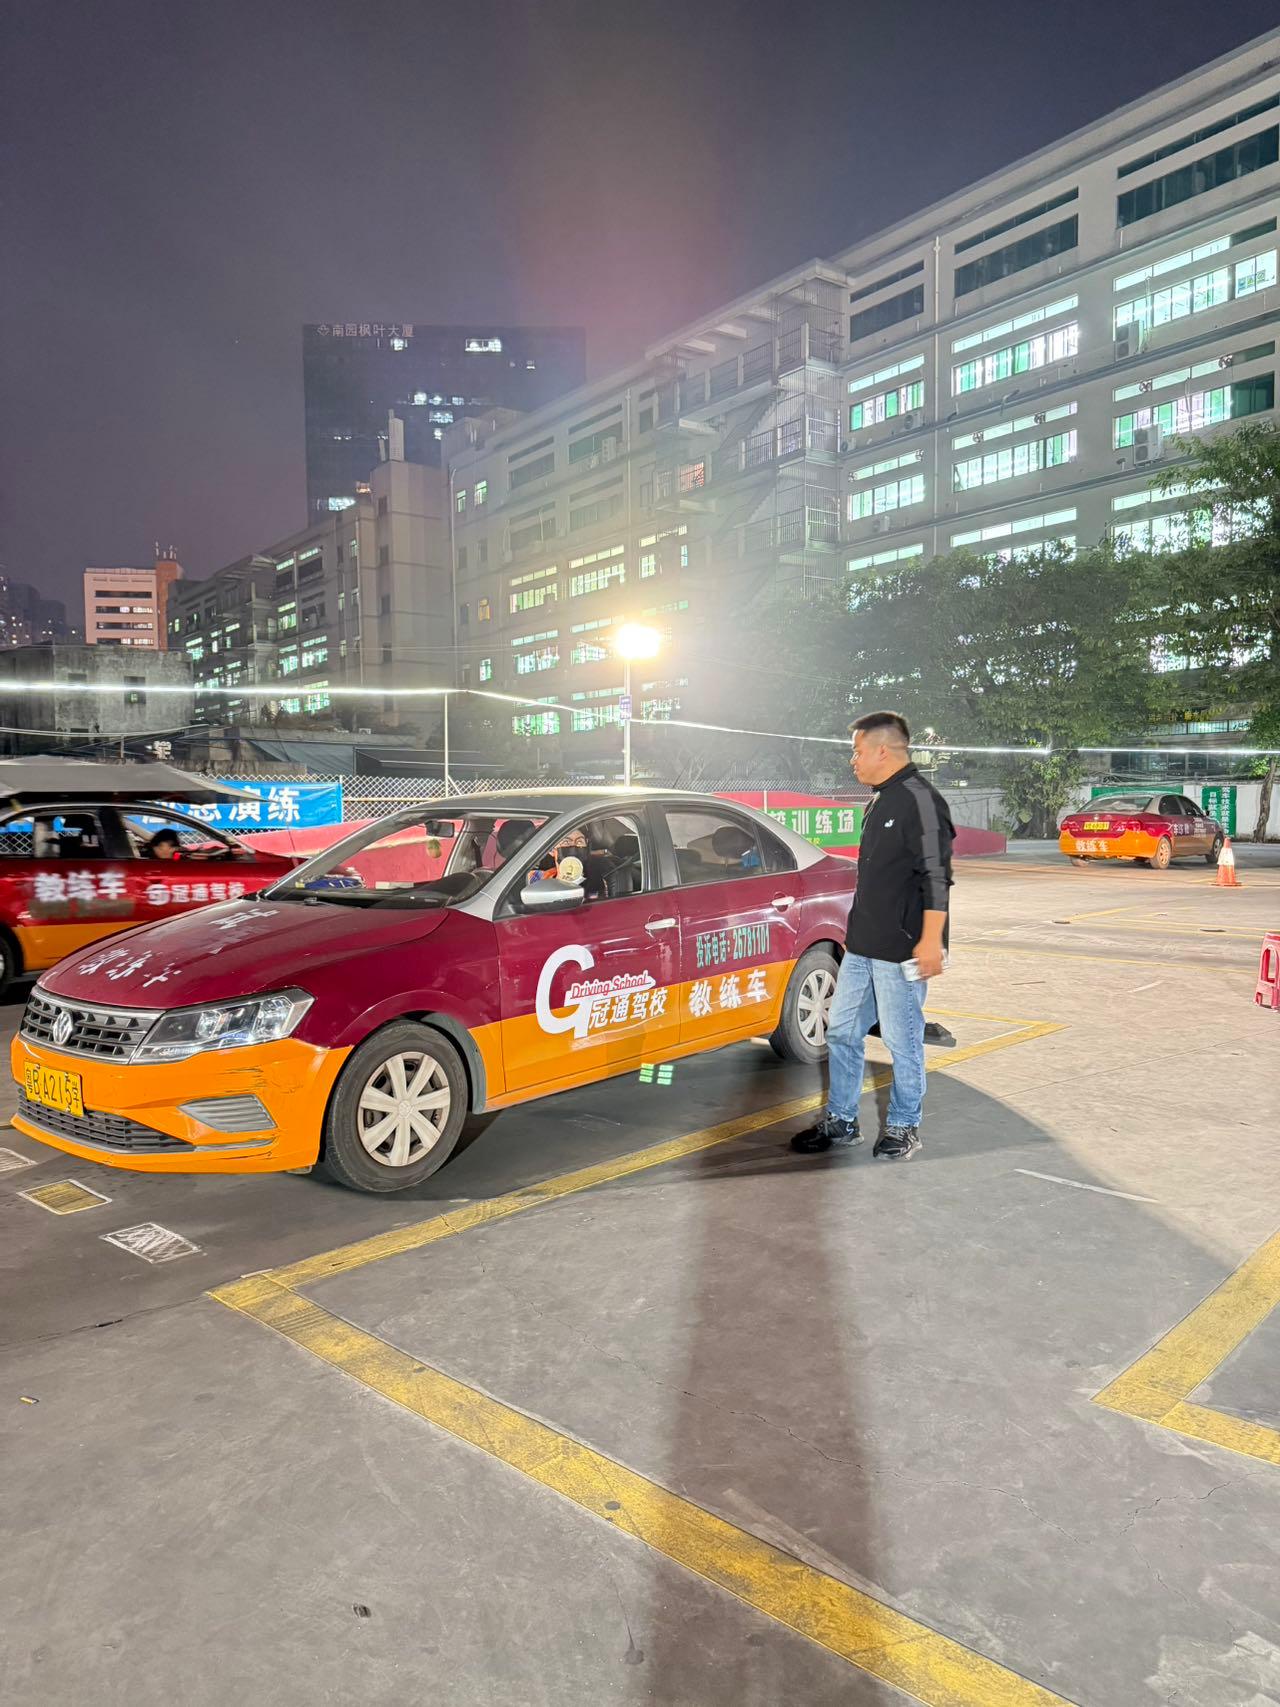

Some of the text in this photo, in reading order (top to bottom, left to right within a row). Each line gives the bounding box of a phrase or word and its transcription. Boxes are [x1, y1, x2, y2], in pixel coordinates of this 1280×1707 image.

[332, 322, 414, 337] 南园枫叶大厦
[34, 872, 126, 902] 教练车
[570, 973, 648, 999] Driving School
[688, 968, 769, 1018] 教练车
[588, 988, 669, 1030] 冠通驾校
